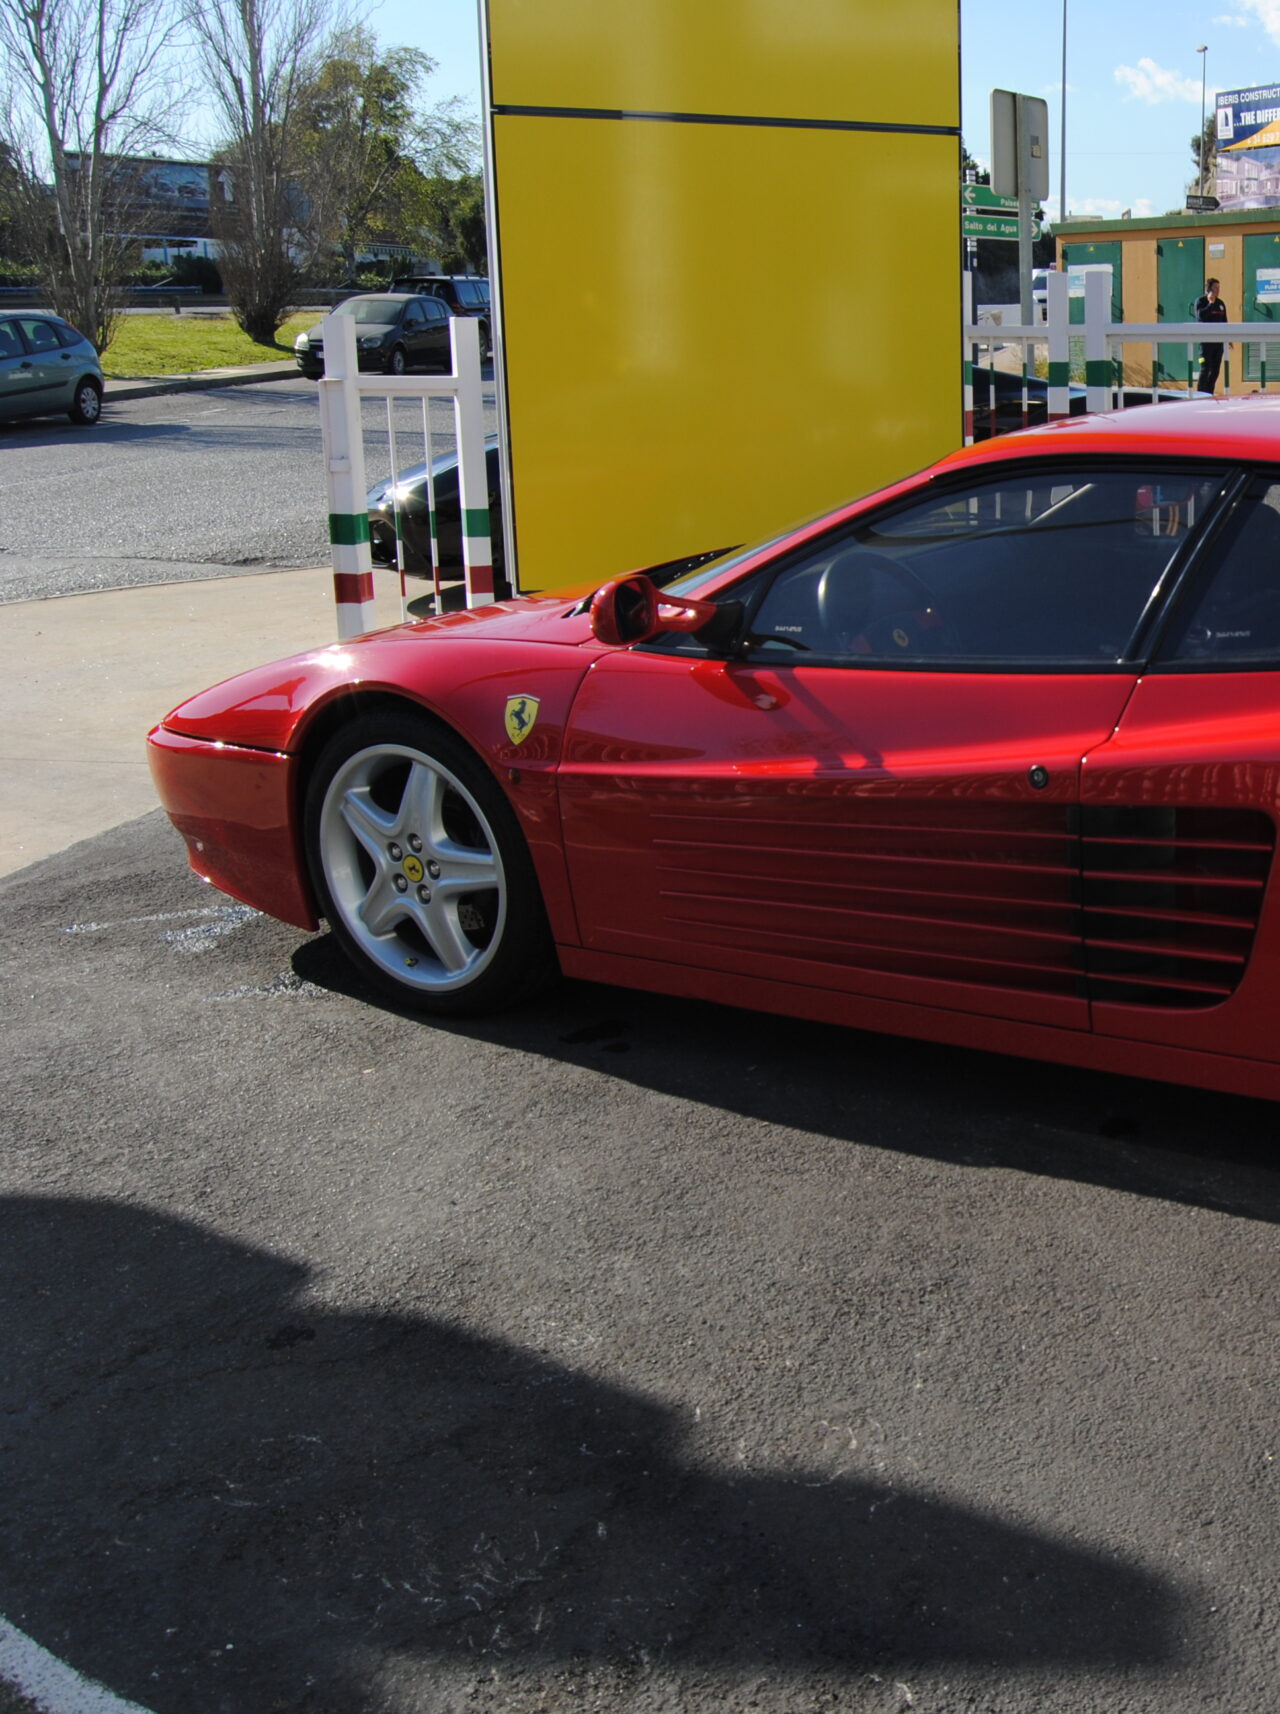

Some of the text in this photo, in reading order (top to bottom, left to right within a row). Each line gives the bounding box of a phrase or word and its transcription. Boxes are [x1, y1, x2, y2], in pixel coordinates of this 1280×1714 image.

[1218, 95, 1239, 106] IBERIS
[964, 221, 1017, 234] Salto del Agua
